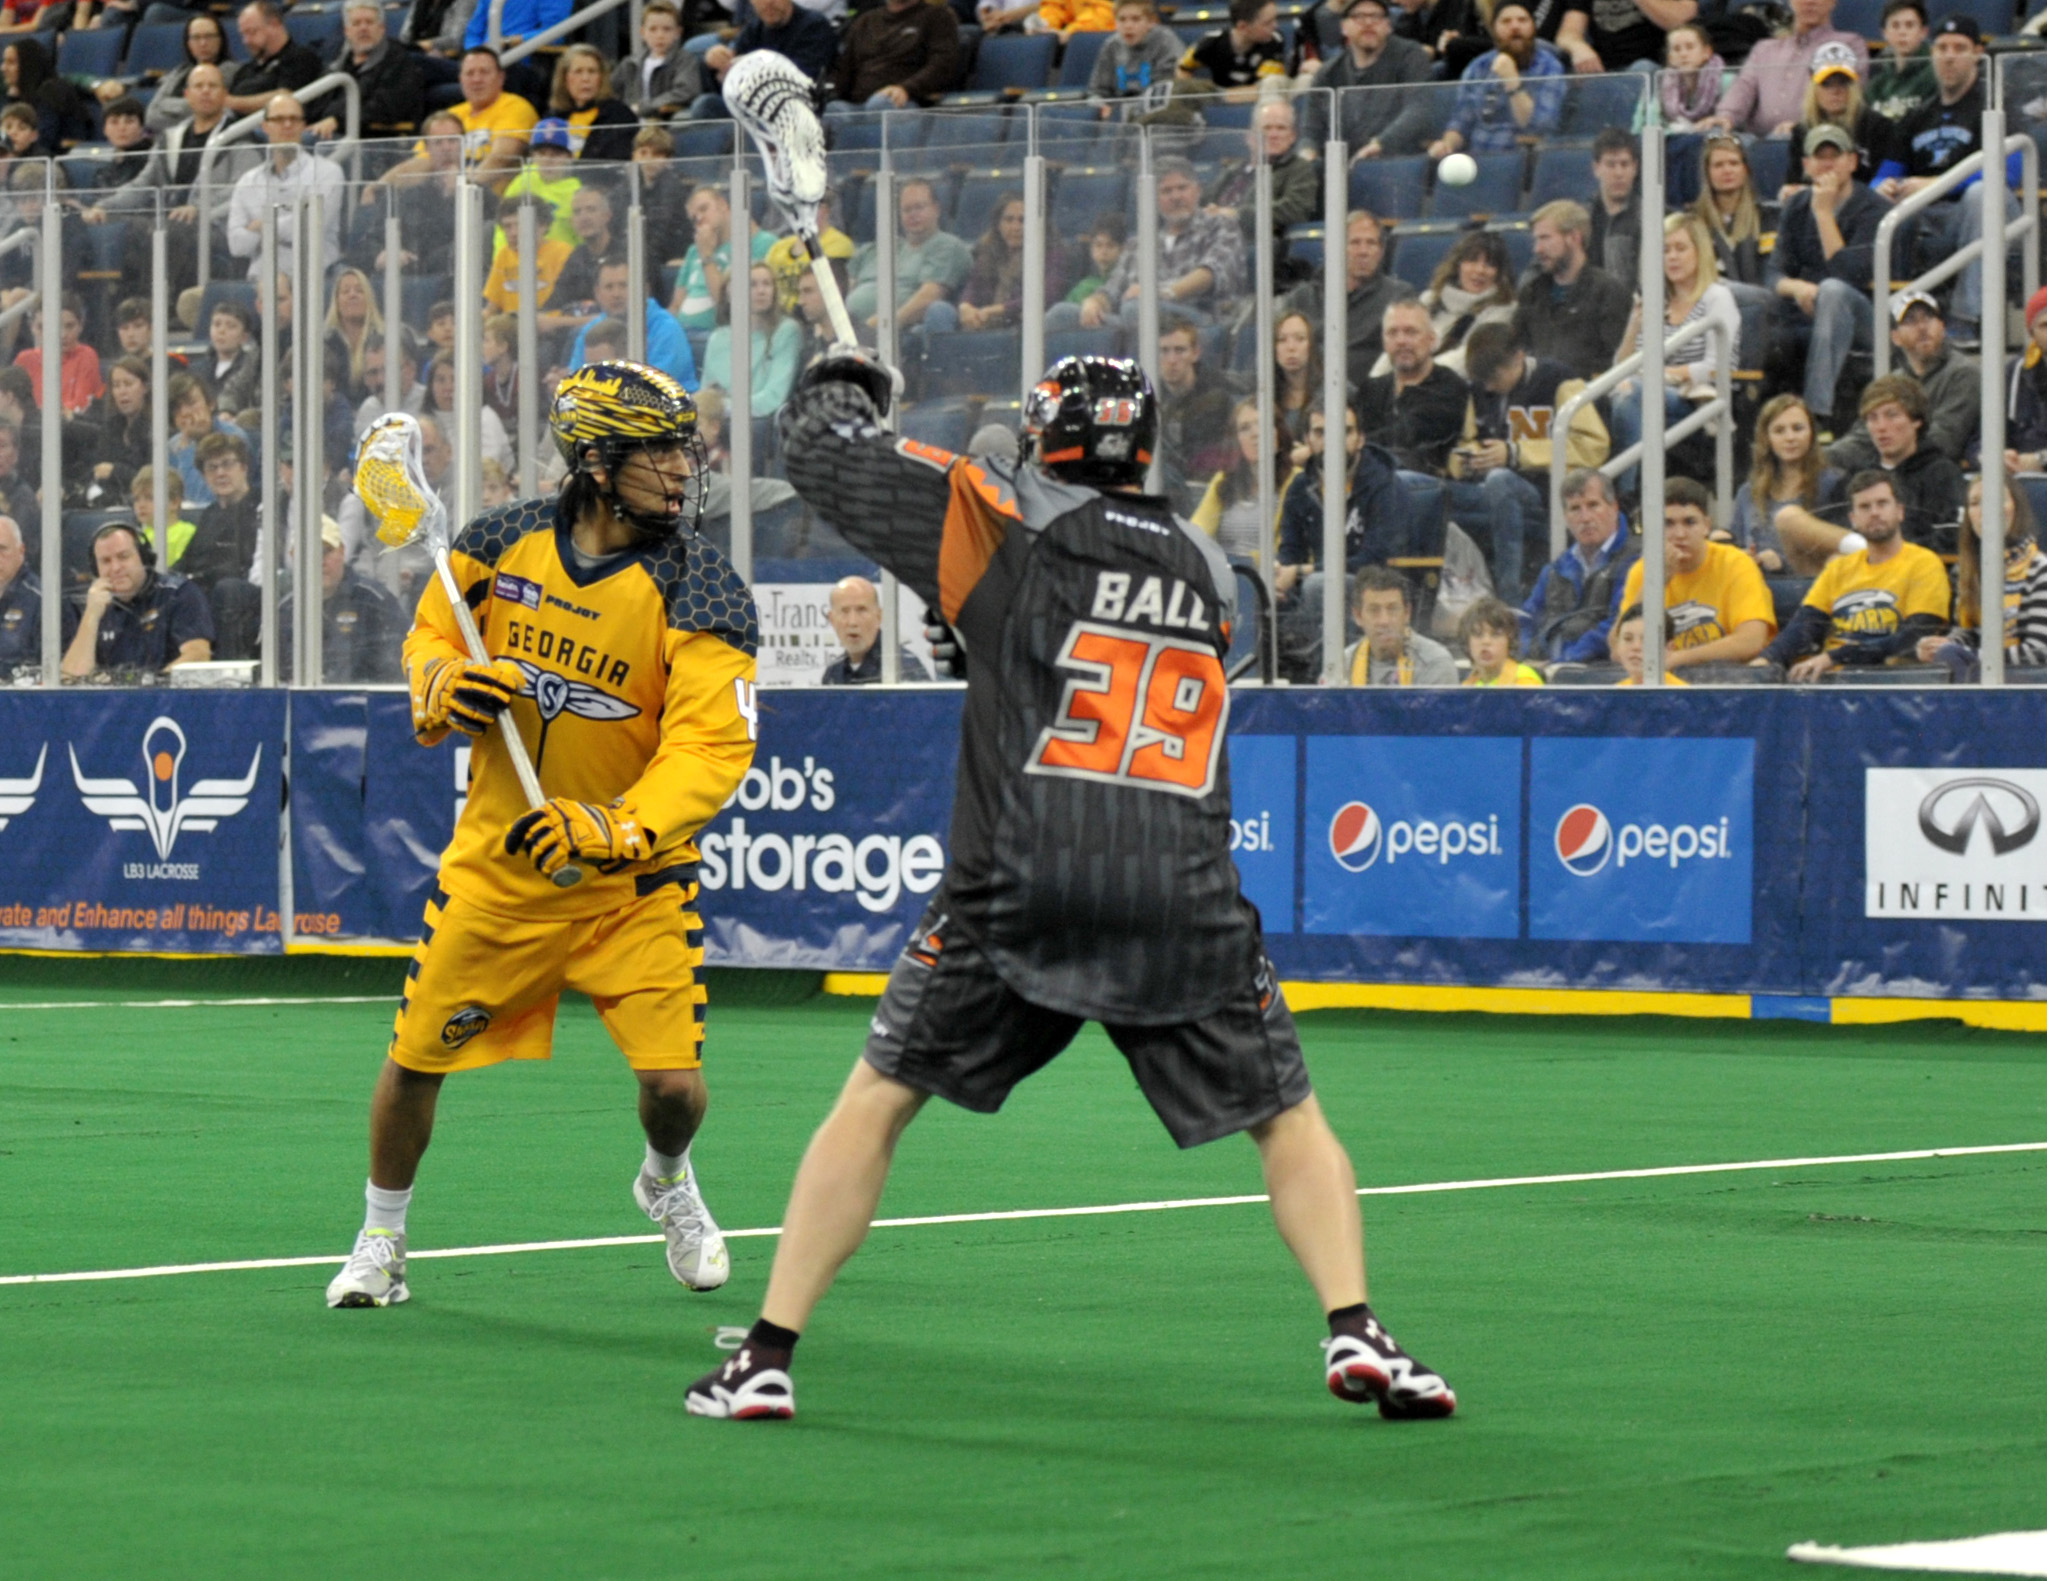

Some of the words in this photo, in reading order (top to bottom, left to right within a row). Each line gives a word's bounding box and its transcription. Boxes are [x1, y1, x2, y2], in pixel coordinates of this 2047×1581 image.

[1506, 406, 1553, 443] N
[1091, 571, 1209, 631] BALL
[508, 621, 630, 687] GEORGIA
[734, 678, 758, 742] 4
[1023, 621, 1230, 799] 39
[721, 756, 835, 811] ob's
[698, 817, 945, 913] storage
[1387, 814, 1498, 864] pepsi
[1617, 816, 1729, 868] pepsi
[123, 863, 145, 879] LB3
[146, 863, 199, 880] LACROSSE
[1879, 881, 2047, 912] INFINI
[36, 902, 71, 928] and
[74, 902, 157, 929] Enhance
[161, 903, 185, 929] all
[188, 904, 249, 937] things
